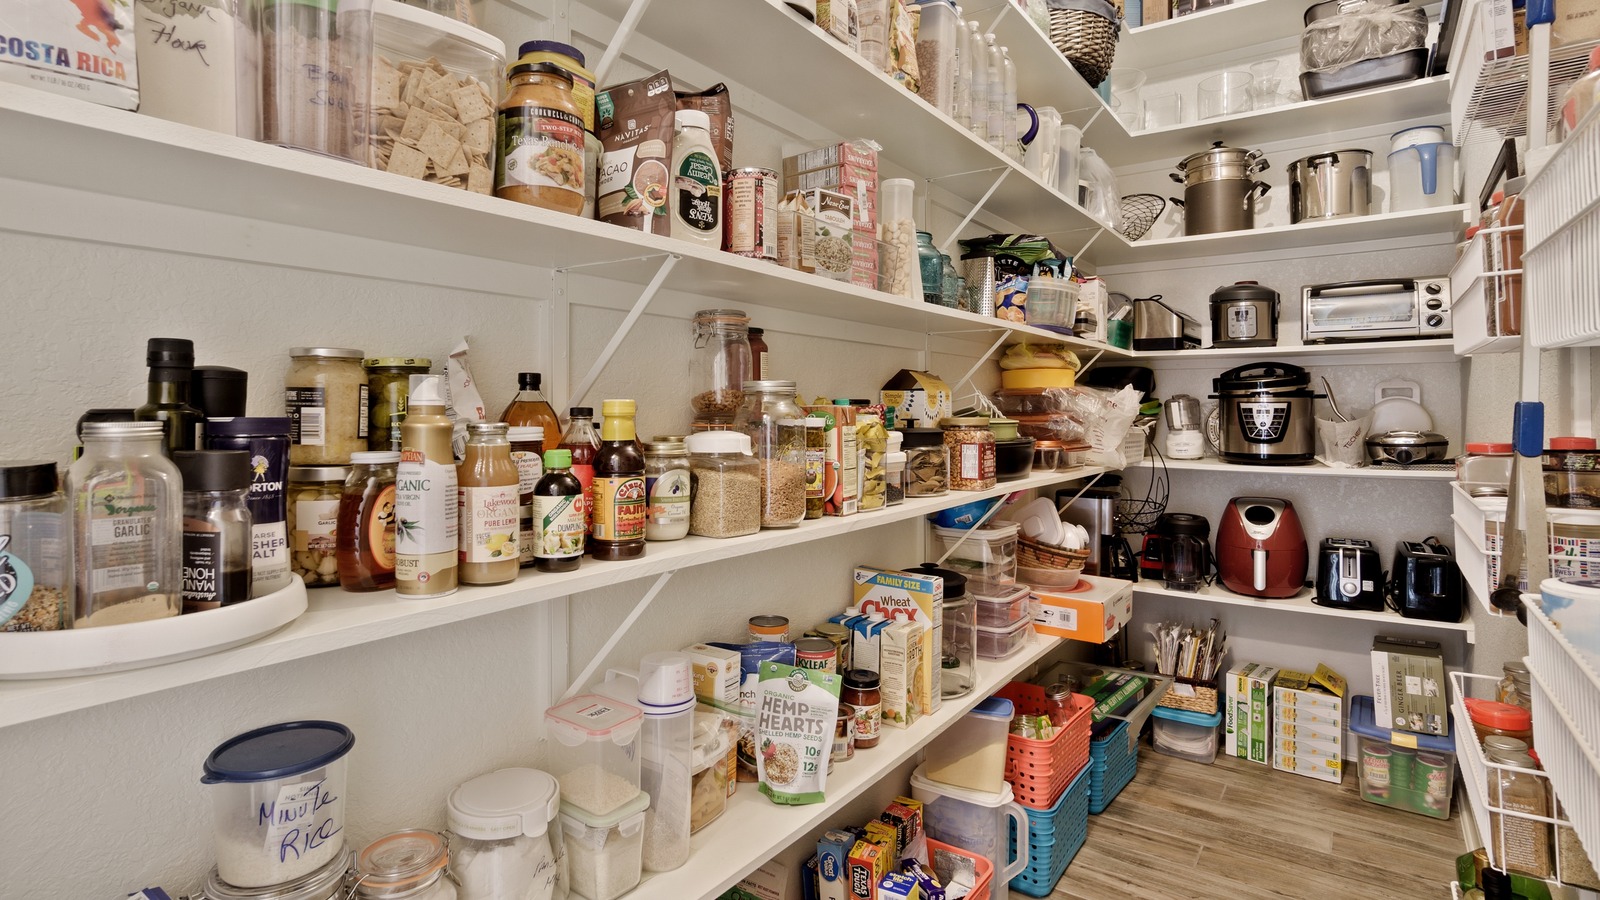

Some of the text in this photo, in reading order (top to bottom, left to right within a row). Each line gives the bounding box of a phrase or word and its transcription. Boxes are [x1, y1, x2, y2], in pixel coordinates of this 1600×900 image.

[76, 50, 127, 81] RICA
[614, 126, 649, 142] NAVITAS
[512, 135, 538, 147] Texas
[884, 392, 902, 400] Simple
[252, 481, 283, 492] RTON
[397, 479, 431, 491] GANIC
[114, 504, 157, 517] organic
[484, 498, 517, 512] Lakewood
[477, 506, 518, 519] ORGANI
[114, 523, 151, 538] GARLIC
[253, 531, 276, 539] ARSE
[253, 538, 285, 550] SHER
[252, 549, 277, 559] ALT
[182, 567, 216, 580] HONE
[182, 578, 216, 591] MANU
[876, 575, 920, 591] FAMILY SIZE
[880, 595, 911, 607] Wheat
[763, 689, 795, 700] ORGANIC
[1397, 688, 1405, 714] GINGER
[761, 696, 809, 716] HEMP
[1226, 696, 1234, 729] FoodSaver
[759, 712, 824, 735] HEARTS
[758, 728, 822, 743] SHELLED HEMP SEEDS
[804, 745, 821, 757] 10g
[803, 761, 818, 772] 12g
[281, 818, 343, 863] Rice
[827, 854, 836, 877] Great
[852, 866, 861, 895] TOUGH
[859, 869, 868, 896] TEXAS
